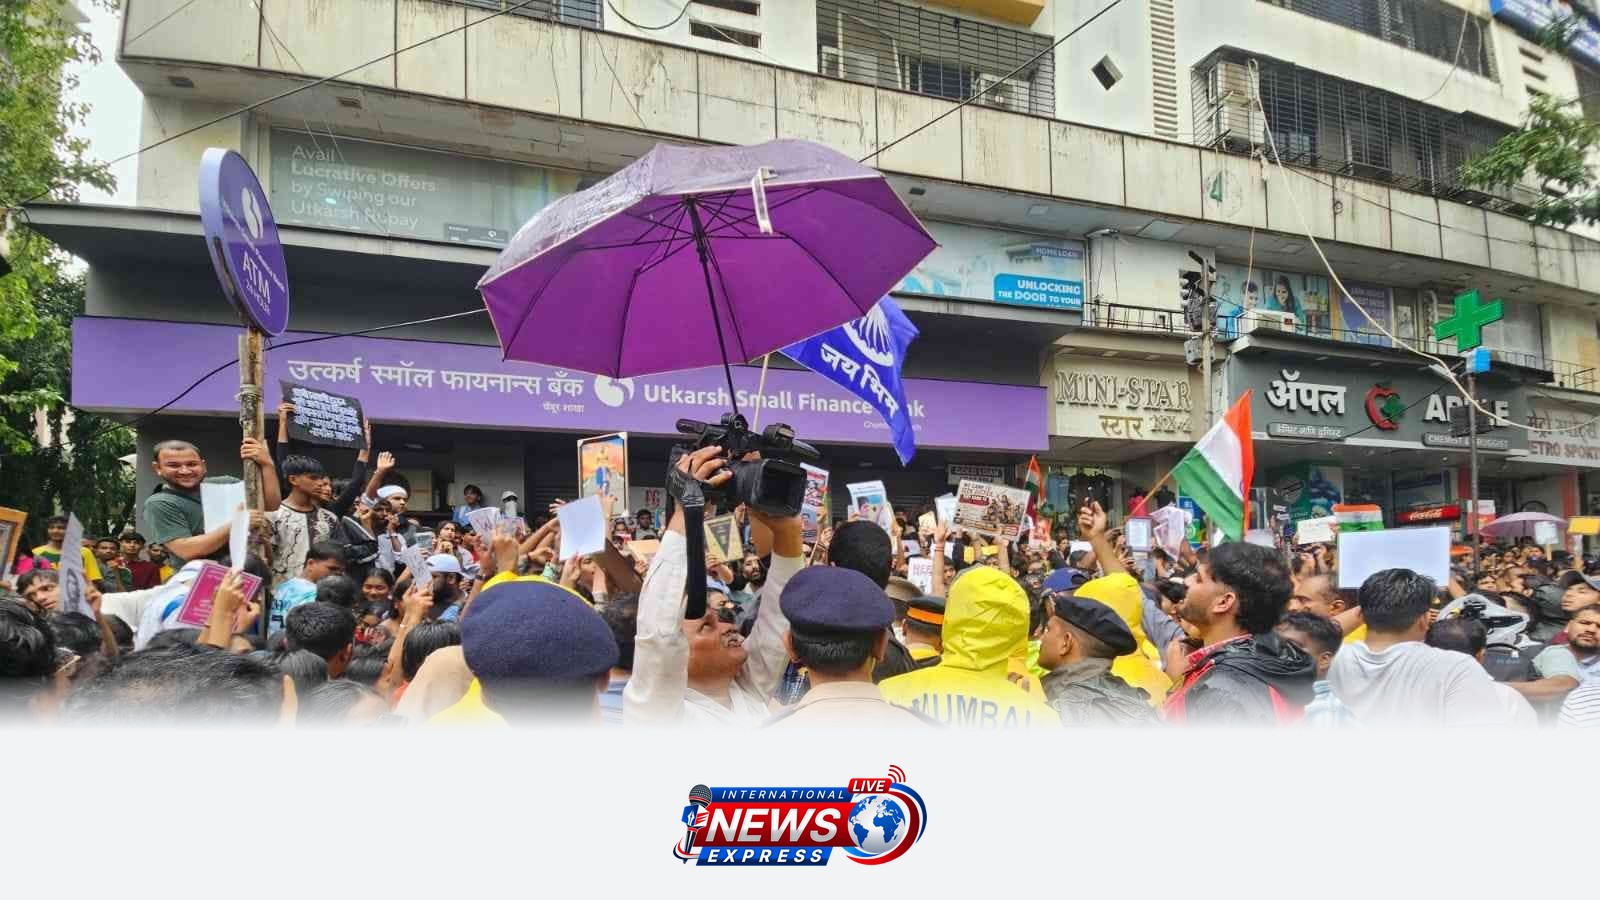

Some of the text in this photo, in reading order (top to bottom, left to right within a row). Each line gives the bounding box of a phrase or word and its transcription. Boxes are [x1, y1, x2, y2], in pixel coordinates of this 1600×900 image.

[291, 145, 335, 161] Avail
[291, 161, 377, 184] Lucrative
[291, 180, 417, 207] by Swiping our
[291, 200, 364, 223] Utkarsh
[243, 251, 271, 304] ATM
[1017, 279, 1081, 295] UNLOCKING
[998, 290, 1081, 305] THE DOOR TO YOUR
[821, 343, 861, 381] जय
[287, 358, 363, 384] उत्कर्ष
[370, 360, 434, 388] स्मॉल
[441, 370, 541, 396] फायनान्स
[643, 383, 730, 407] Utkarsh
[736, 389, 793, 410] Small
[798, 393, 873, 415] Finance
[1056, 371, 1193, 412] MINI-STAR
[1423, 393, 1510, 427] APE
[1099, 414, 1144, 438] स्टार
